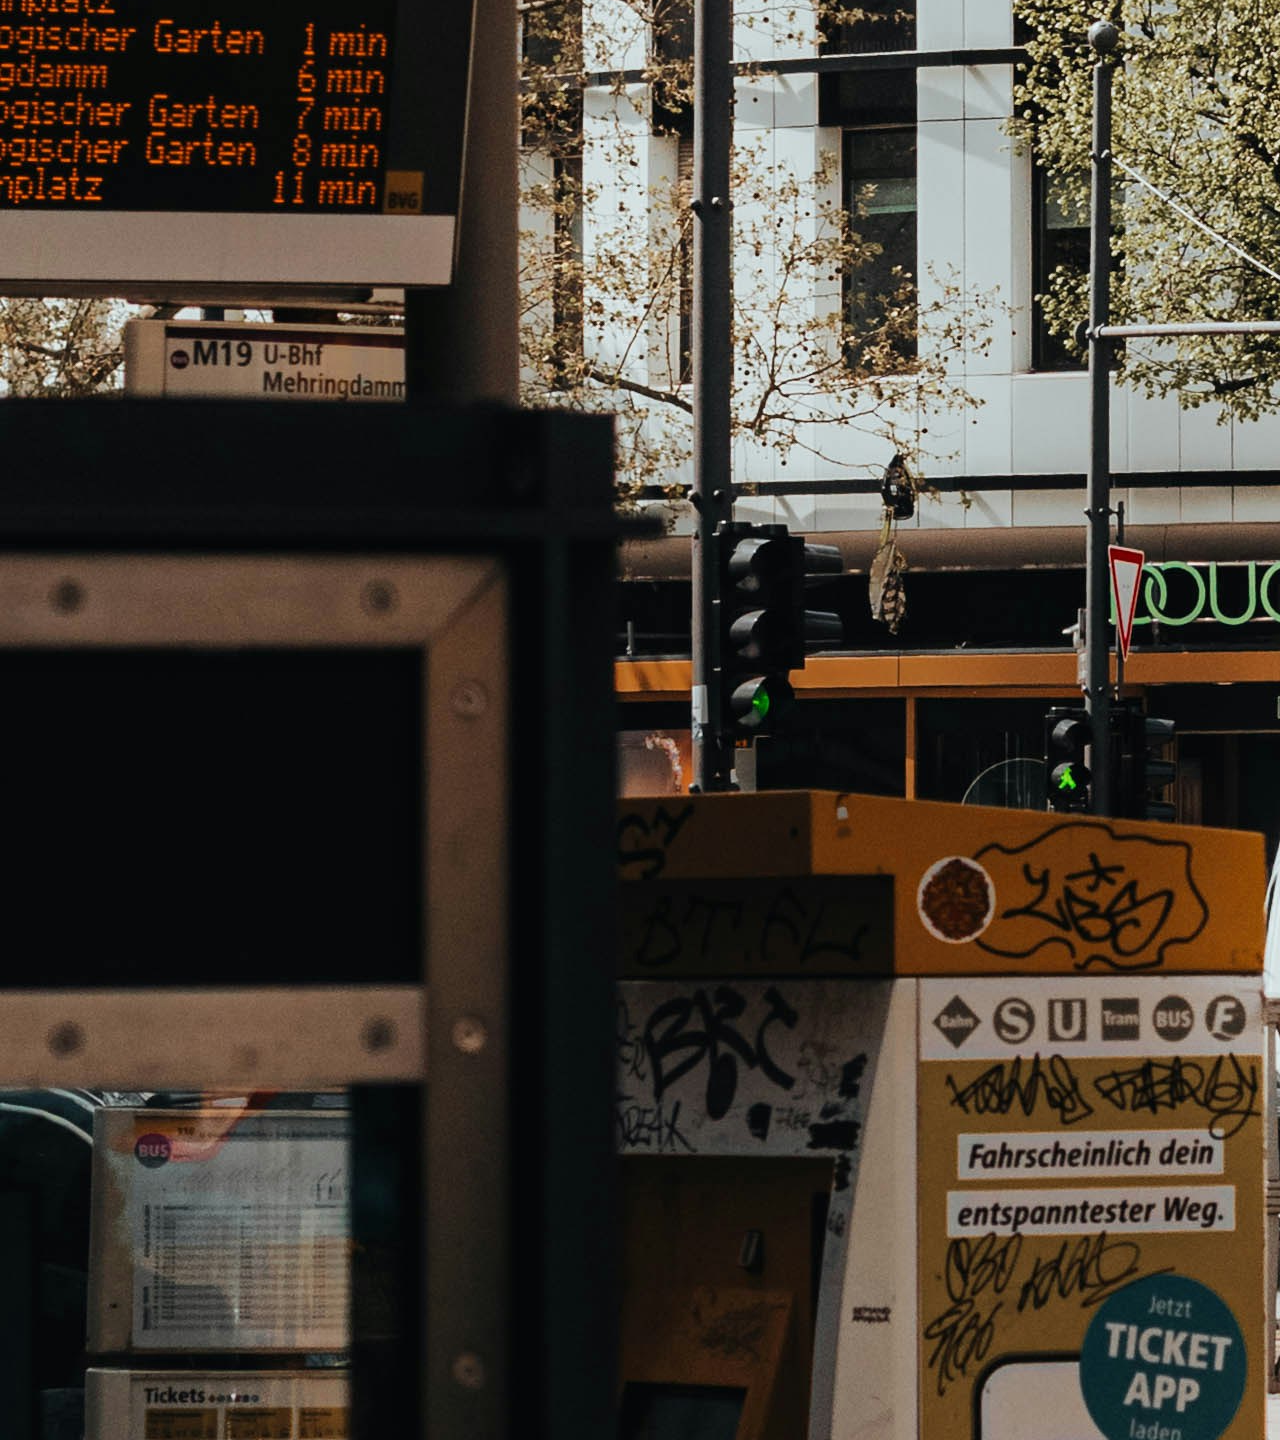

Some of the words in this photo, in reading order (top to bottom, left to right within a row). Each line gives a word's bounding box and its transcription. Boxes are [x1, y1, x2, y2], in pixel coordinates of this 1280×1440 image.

[153, 19, 265, 55] Garten
[304, 22, 315, 56] 1
[329, 23, 388, 57] min
[297, 60, 316, 94] 6
[326, 60, 385, 94] min
[149, 94, 259, 129] Garten
[297, 97, 315, 130] 7
[323, 98, 382, 131] min
[145, 131, 256, 166] Garten
[292, 134, 312, 167] 8
[321, 135, 379, 168] min
[273, 171, 304, 204] 11
[318, 172, 376, 205] min
[387, 191, 418, 209] BVG
[192, 340, 252, 367] M19
[263, 344, 323, 366] U-Bhf
[263, 370, 406, 400] Mehringdamm
[1000, 1001, 1030, 1041] S
[1053, 1001, 1081, 1040] U
[1102, 1009, 1139, 1026] Tram
[1155, 1009, 1191, 1028] BUS
[138, 1144, 169, 1158] BUS
[968, 1138, 1151, 1170] Fahrscheinlich
[1158, 1138, 1214, 1166] dein
[957, 1200, 1156, 1232] entspanntester
[1163, 1197, 1224, 1229] Weg.
[1148, 1295, 1193, 1319] Jetzt
[1105, 1322, 1233, 1372] TICKET
[143, 1386, 206, 1405] Tickets
[1123, 1372, 1200, 1413] APP
